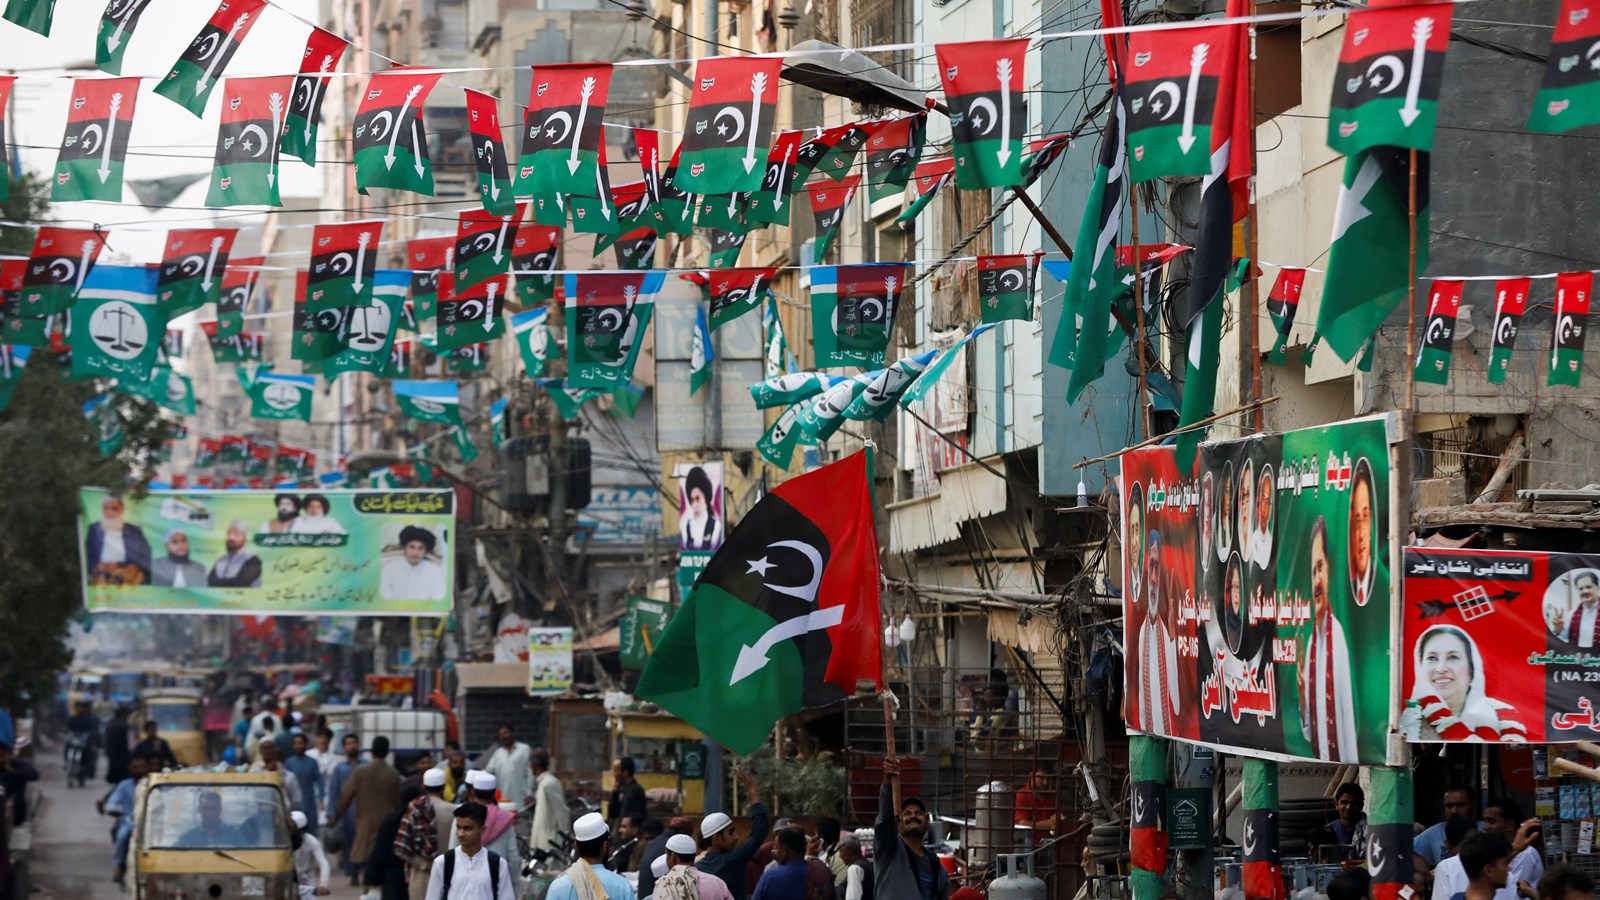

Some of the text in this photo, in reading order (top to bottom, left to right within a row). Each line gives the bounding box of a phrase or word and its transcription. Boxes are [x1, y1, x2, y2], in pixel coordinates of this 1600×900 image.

[1410, 560, 1529, 577] انتخابی نشان تیر
[1262, 590, 1277, 621] احمد
[1202, 647, 1277, 727] الیکشن آفس
